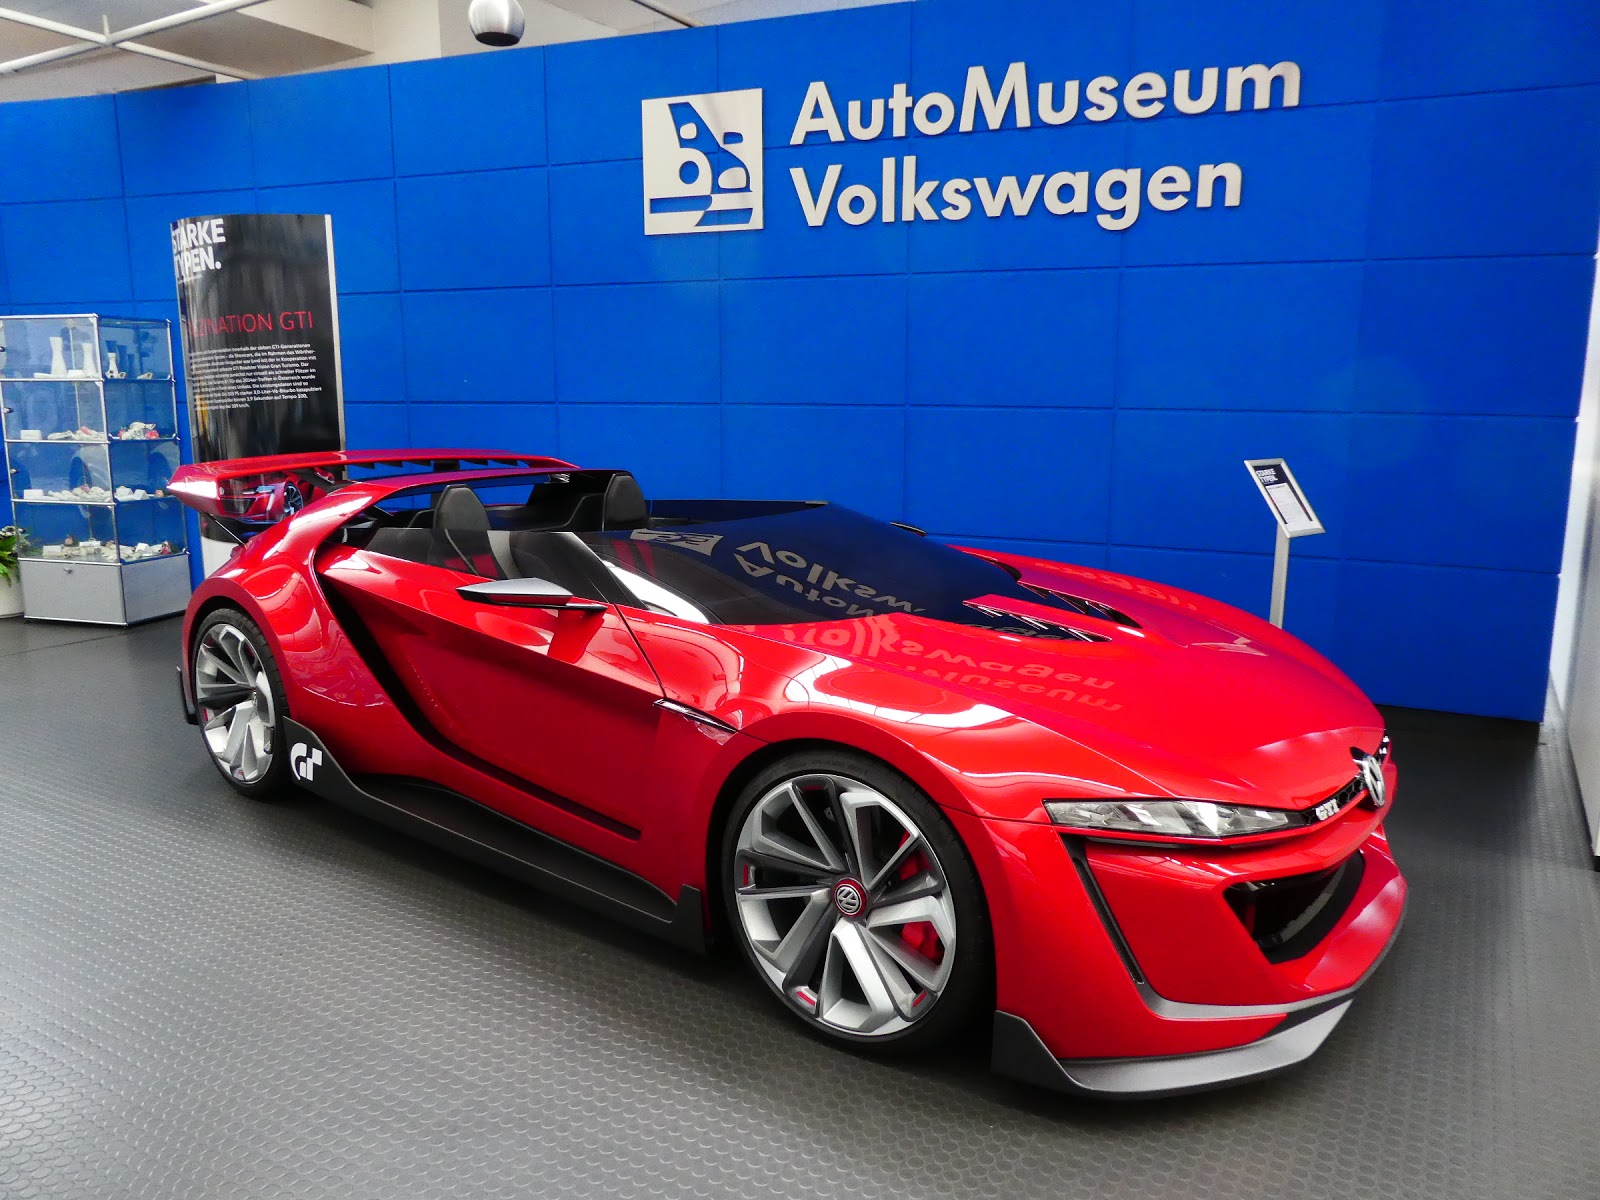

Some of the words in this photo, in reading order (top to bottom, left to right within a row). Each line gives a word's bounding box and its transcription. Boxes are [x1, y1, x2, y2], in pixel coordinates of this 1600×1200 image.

[789, 61, 1301, 145] AutoMuseum
[790, 155, 1242, 231] Volkswagen
[279, 311, 313, 330] GTI
[1315, 798, 1340, 821] GTI
